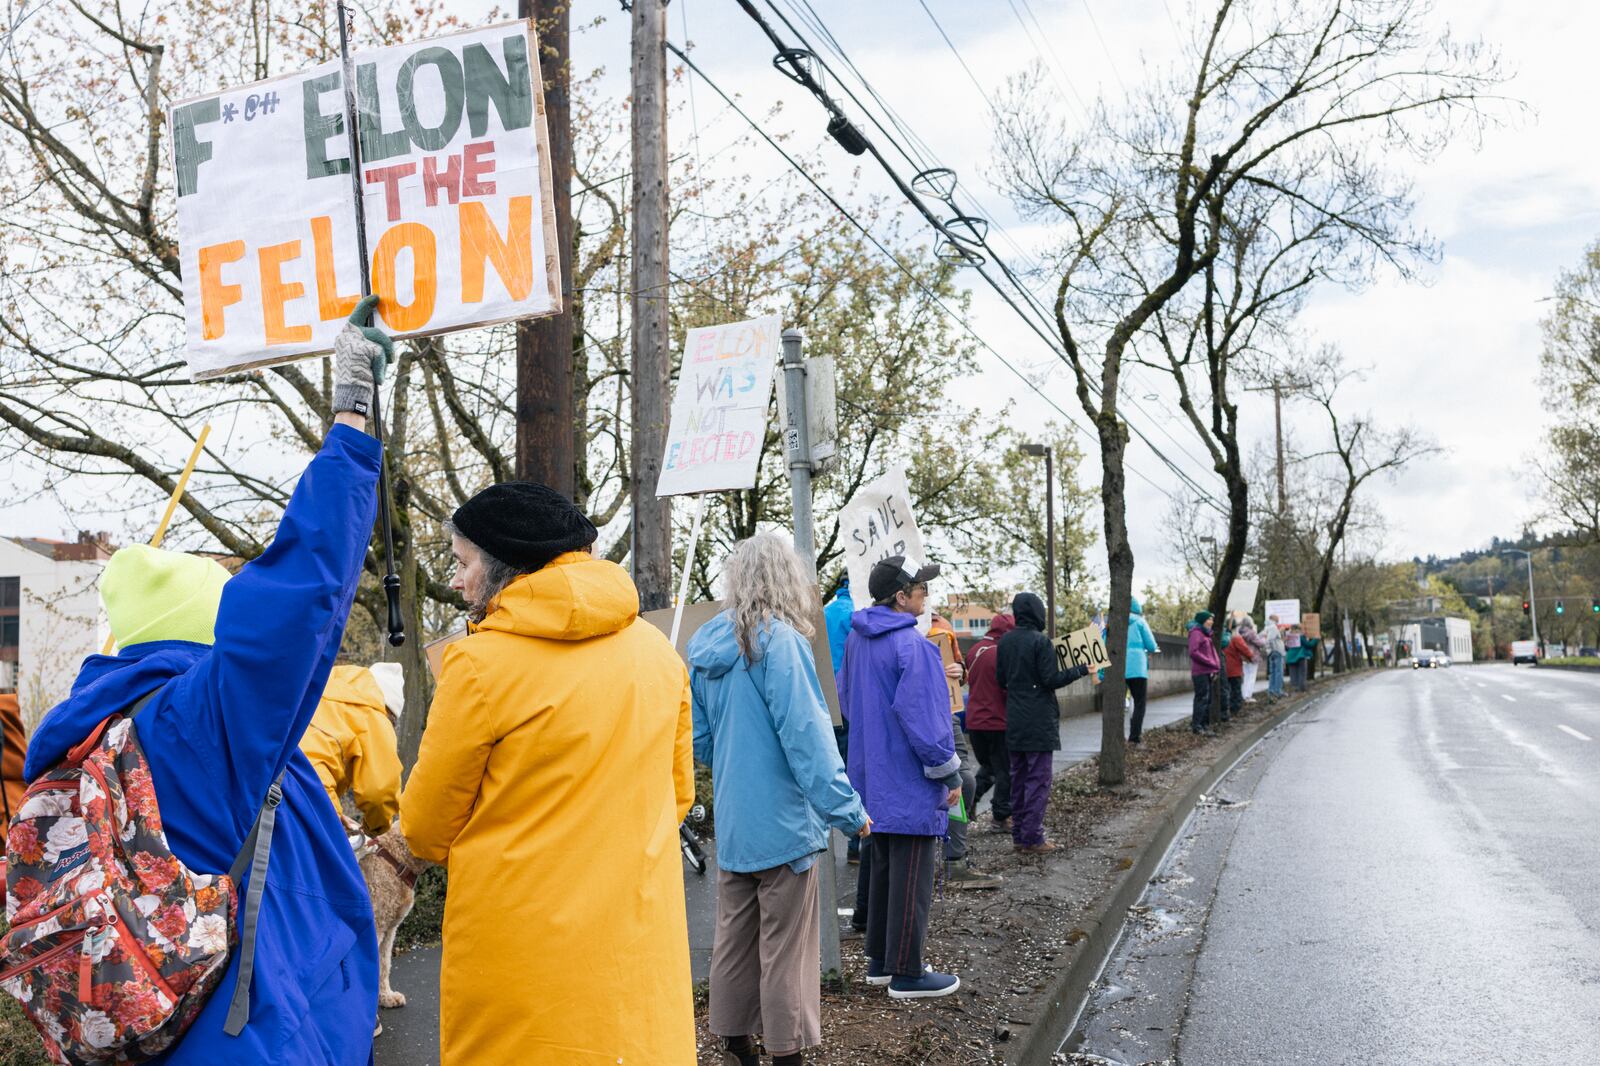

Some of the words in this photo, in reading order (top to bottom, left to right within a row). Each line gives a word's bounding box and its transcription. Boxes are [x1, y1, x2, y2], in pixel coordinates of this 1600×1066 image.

[303, 34, 532, 180] ELON
[365, 141, 496, 222] THE
[199, 196, 532, 345] FELON
[694, 324, 776, 363] ELON
[696, 361, 756, 404] WAS
[685, 402, 738, 435] NOT
[666, 431, 755, 470] ELECTED
[853, 495, 904, 556] SAVE
